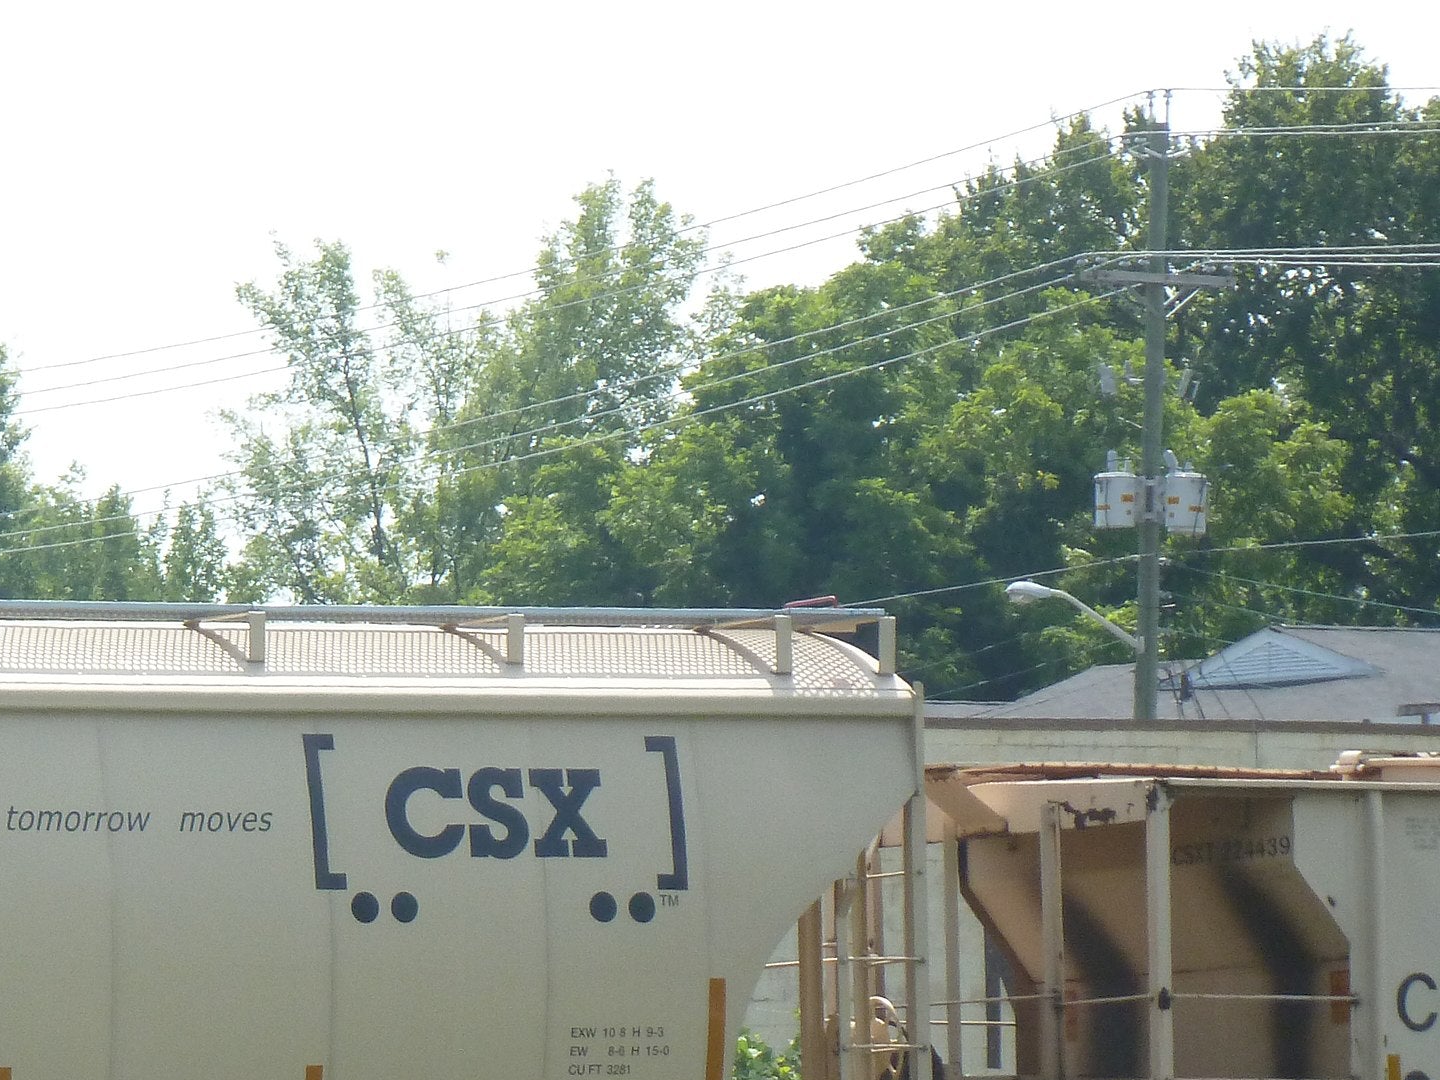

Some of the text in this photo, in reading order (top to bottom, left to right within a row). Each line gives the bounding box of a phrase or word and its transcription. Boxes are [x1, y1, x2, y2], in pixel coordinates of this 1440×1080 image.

[7, 805, 151, 833] tomorrow
[179, 810, 273, 833] moves
[384, 766, 608, 859] CSX
[660, 894, 680, 908] TM
[570, 1027, 597, 1039] EXW
[632, 1026, 641, 1038] H
[569, 1046, 588, 1057] EW
[631, 1046, 640, 1056] H
[645, 1044, 670, 1056] 15-0
[568, 1064, 586, 1076] CU
[588, 1063, 603, 1075] FT
